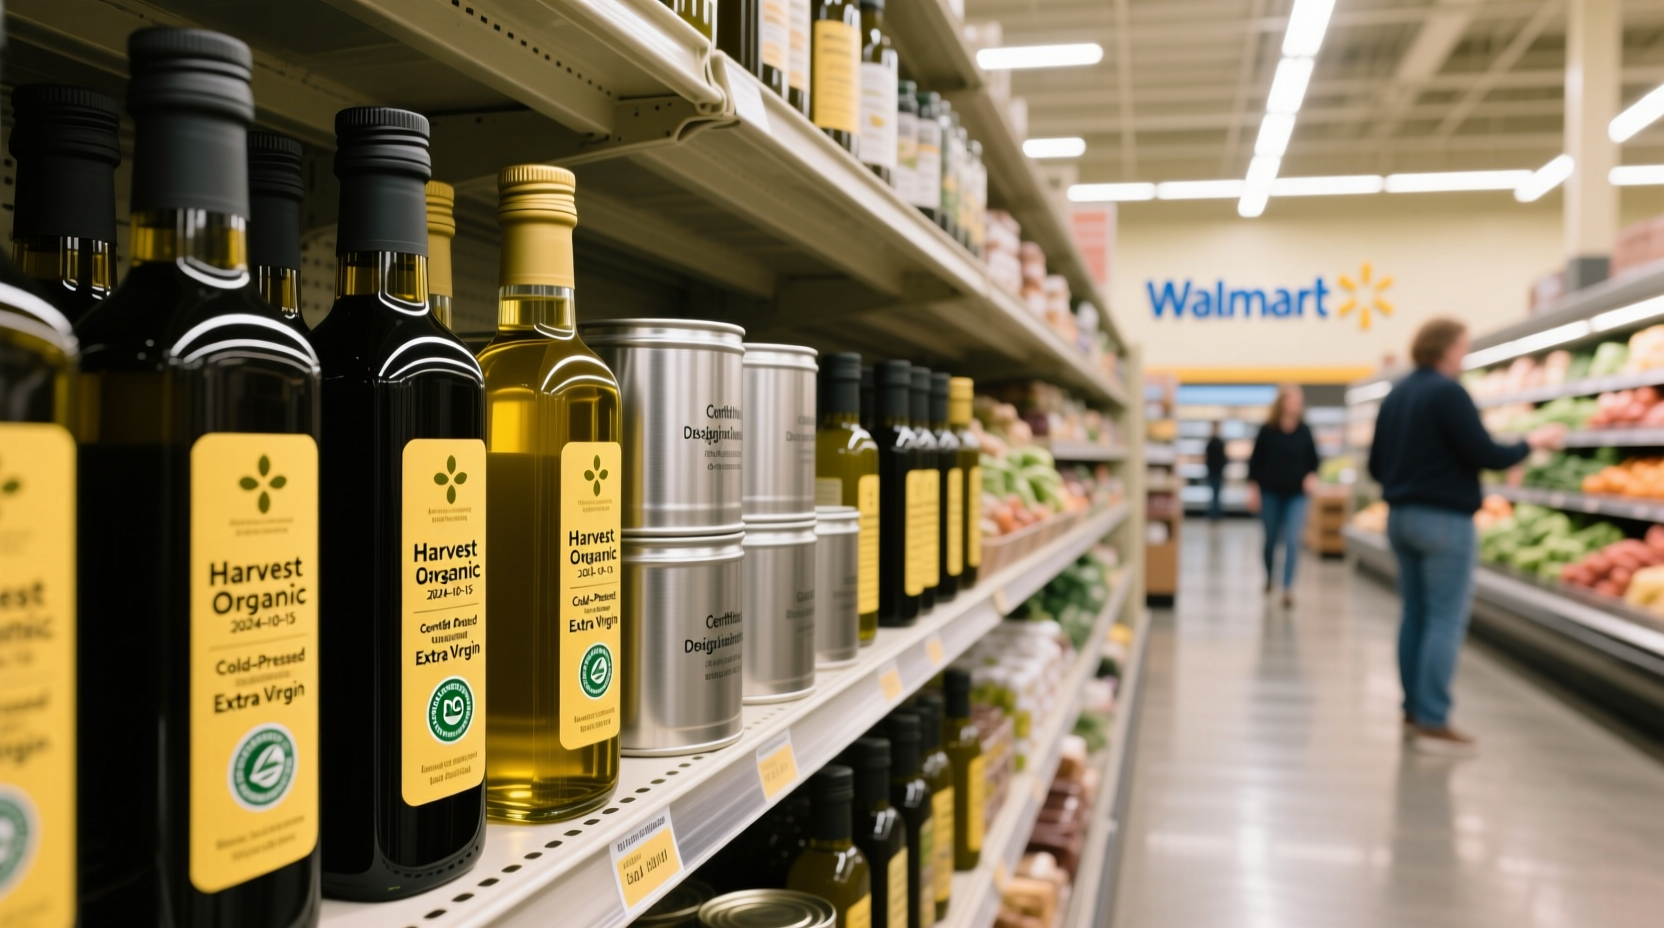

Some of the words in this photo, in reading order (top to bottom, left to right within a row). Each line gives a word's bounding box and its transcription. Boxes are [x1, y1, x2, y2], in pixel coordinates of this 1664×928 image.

[1146, 276, 1330, 318] Walmart
[413, 539, 478, 563] Harvest
[569, 529, 615, 547] Harvest
[209, 556, 303, 586] Harvest
[212, 583, 306, 616] Organic
[230, 612, 296, 633] 2024-10-15
[215, 647, 306, 676] Cold-Pressed
[213, 692, 260, 714] Extra
[264, 680, 305, 705] Virgin
